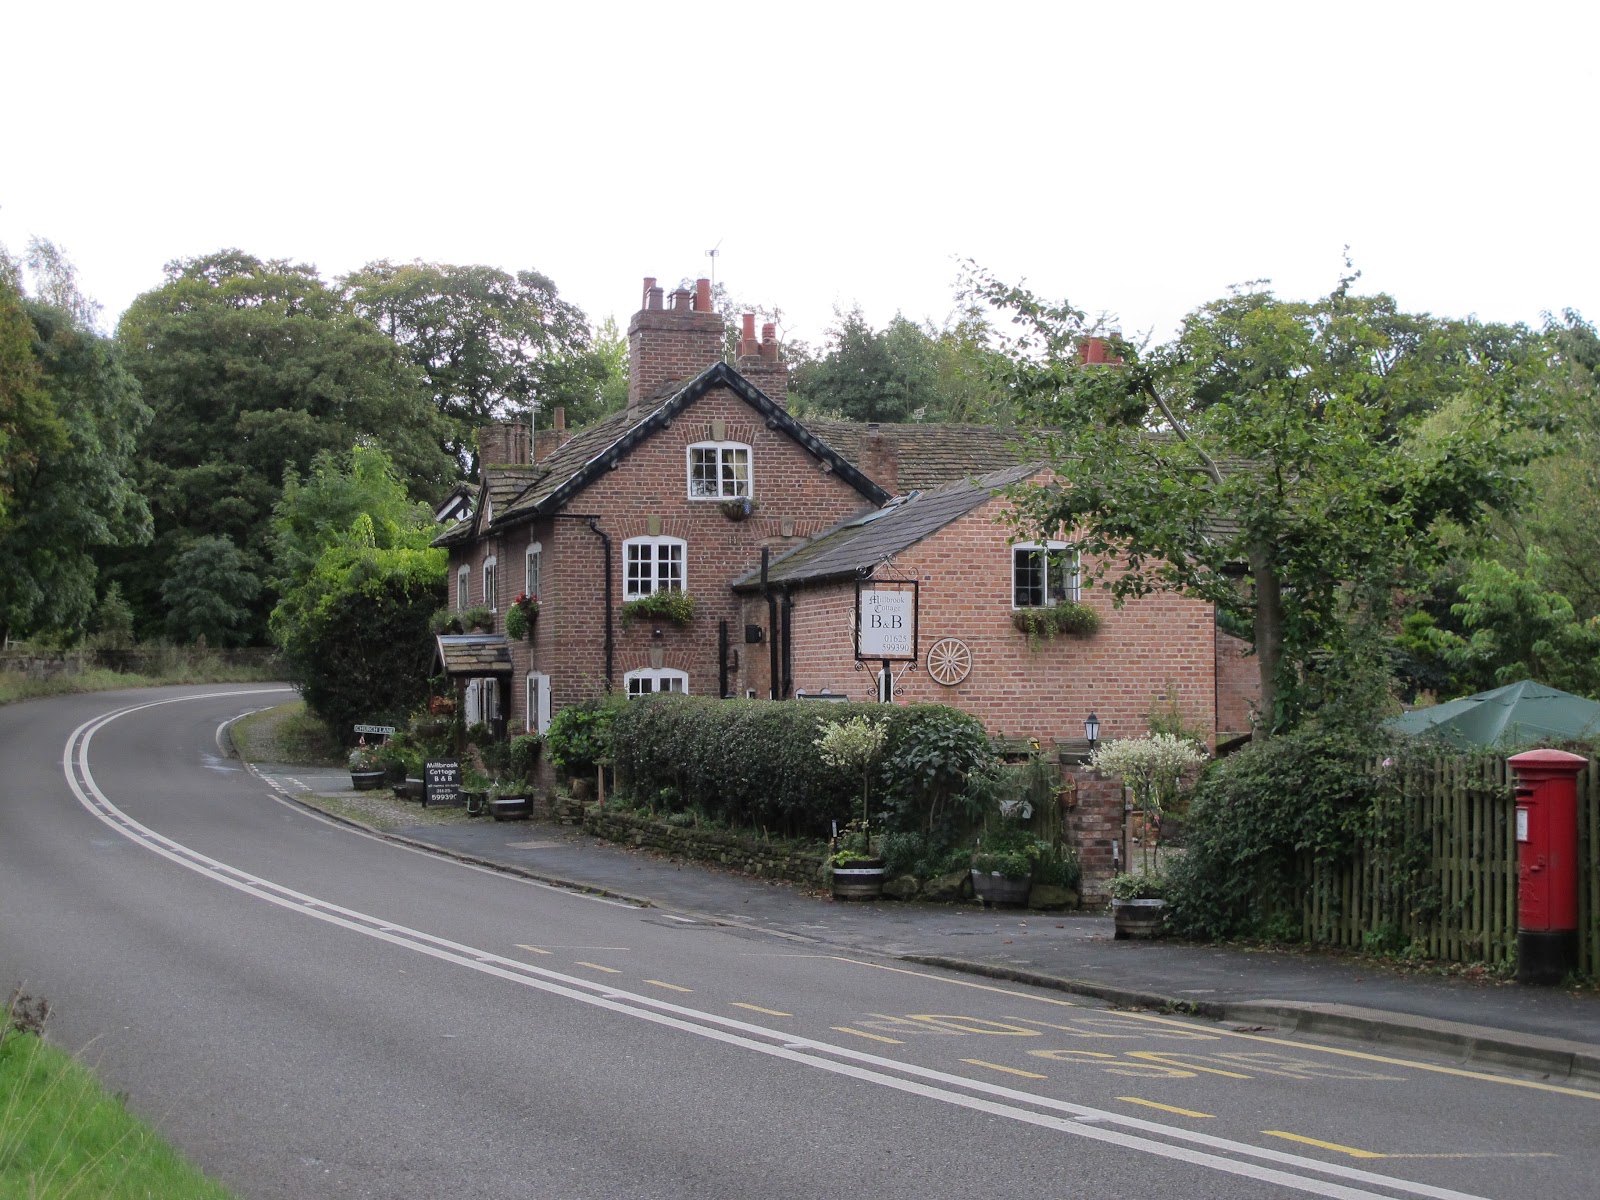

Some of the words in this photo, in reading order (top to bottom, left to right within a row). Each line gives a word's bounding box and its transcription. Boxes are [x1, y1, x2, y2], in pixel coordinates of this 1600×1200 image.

[869, 595, 905, 605] Millbrook
[874, 605, 901, 613] Cottage
[871, 614, 902, 629] B&B
[884, 634, 907, 642] 01625
[882, 643, 909, 652] 599390
[355, 725, 379, 733] CHURCH
[1025, 1049, 1410, 1080] BUS
